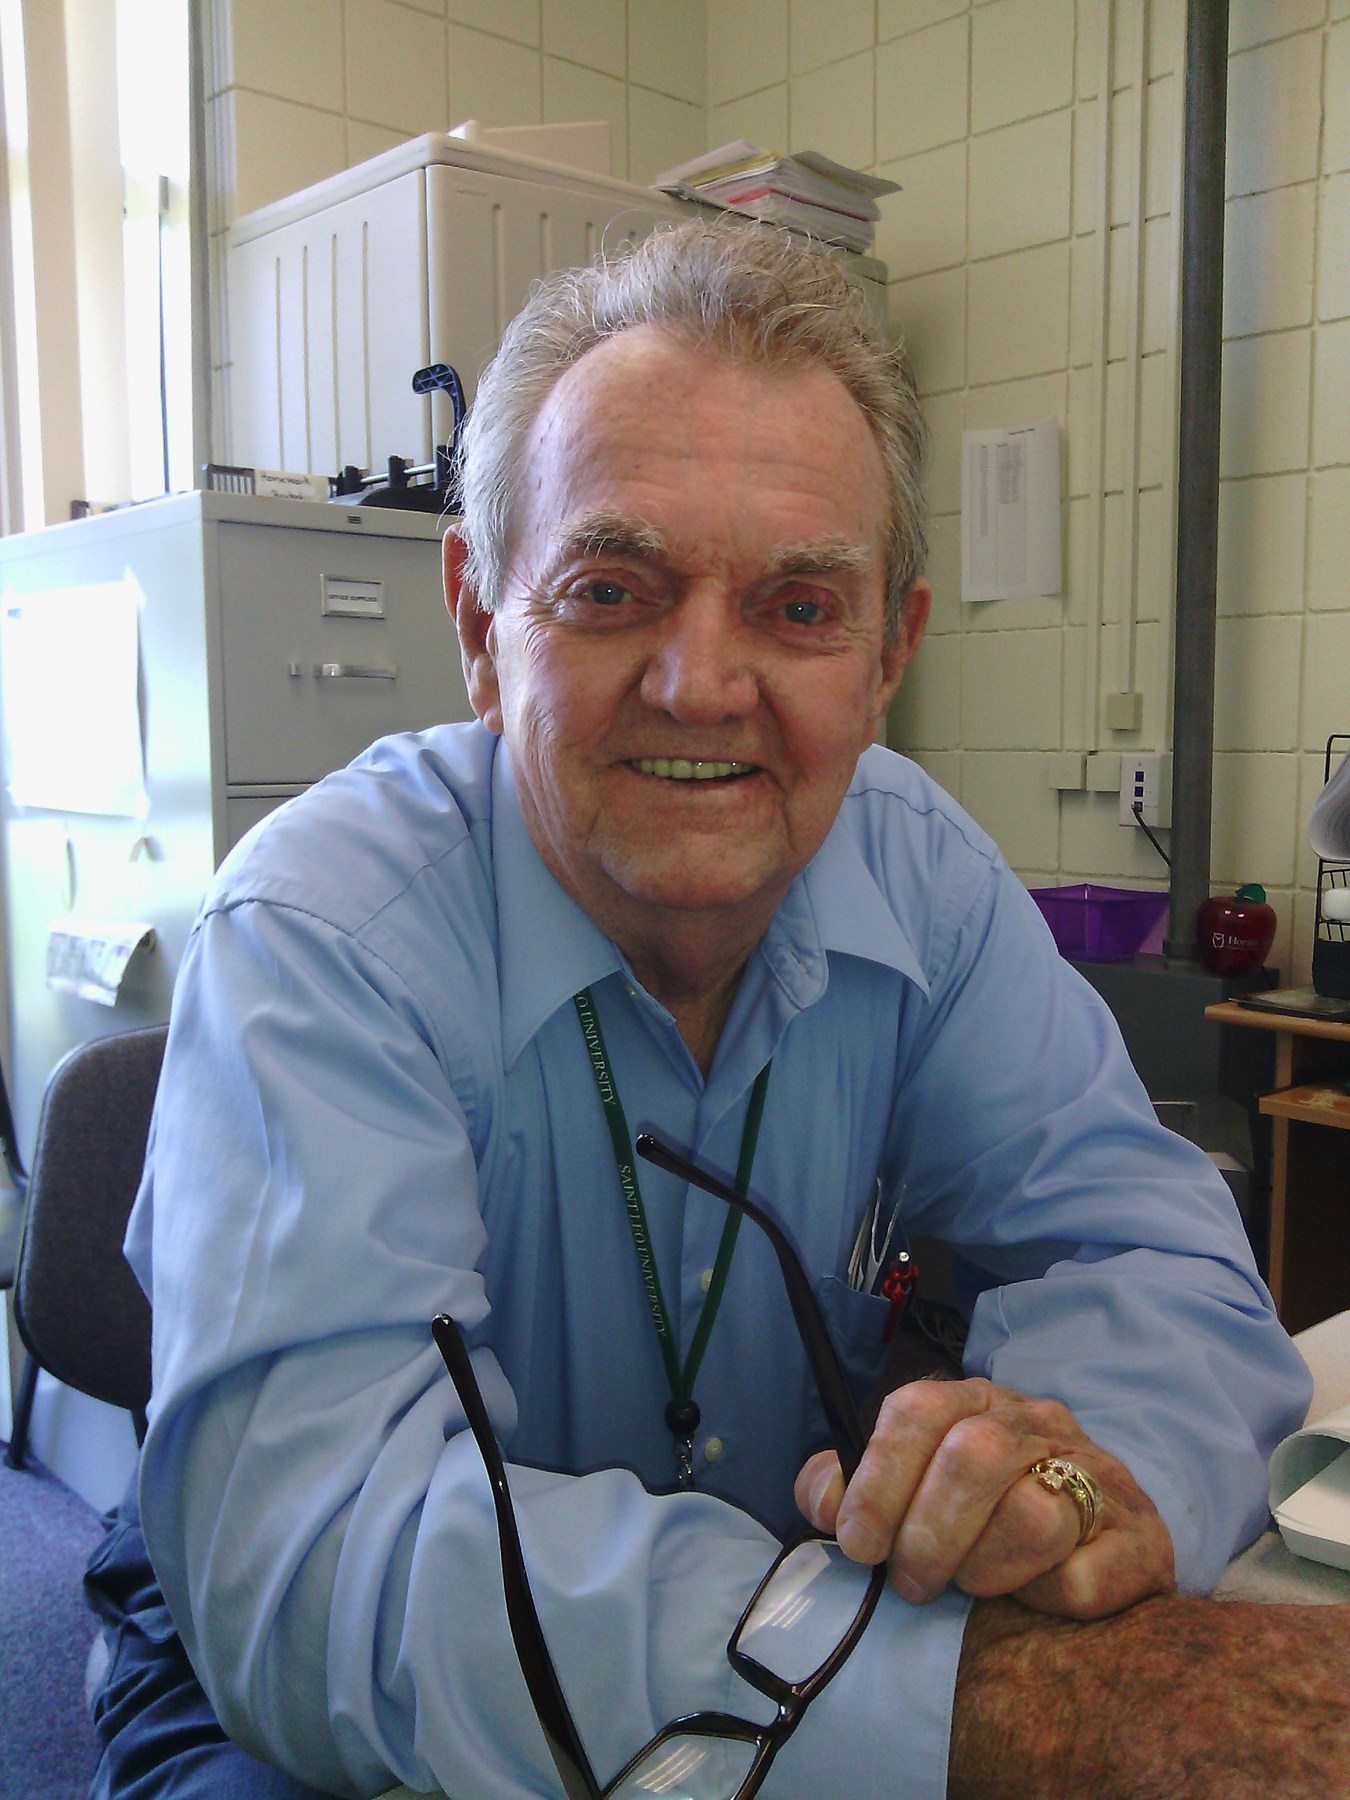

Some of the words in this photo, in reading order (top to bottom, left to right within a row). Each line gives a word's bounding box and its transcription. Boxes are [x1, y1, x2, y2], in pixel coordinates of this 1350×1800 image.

[581, 1011, 616, 1105] UNIVERSITY
[619, 1164, 640, 1212] SAINT
[637, 1247, 667, 1337] UNIVERSITY
